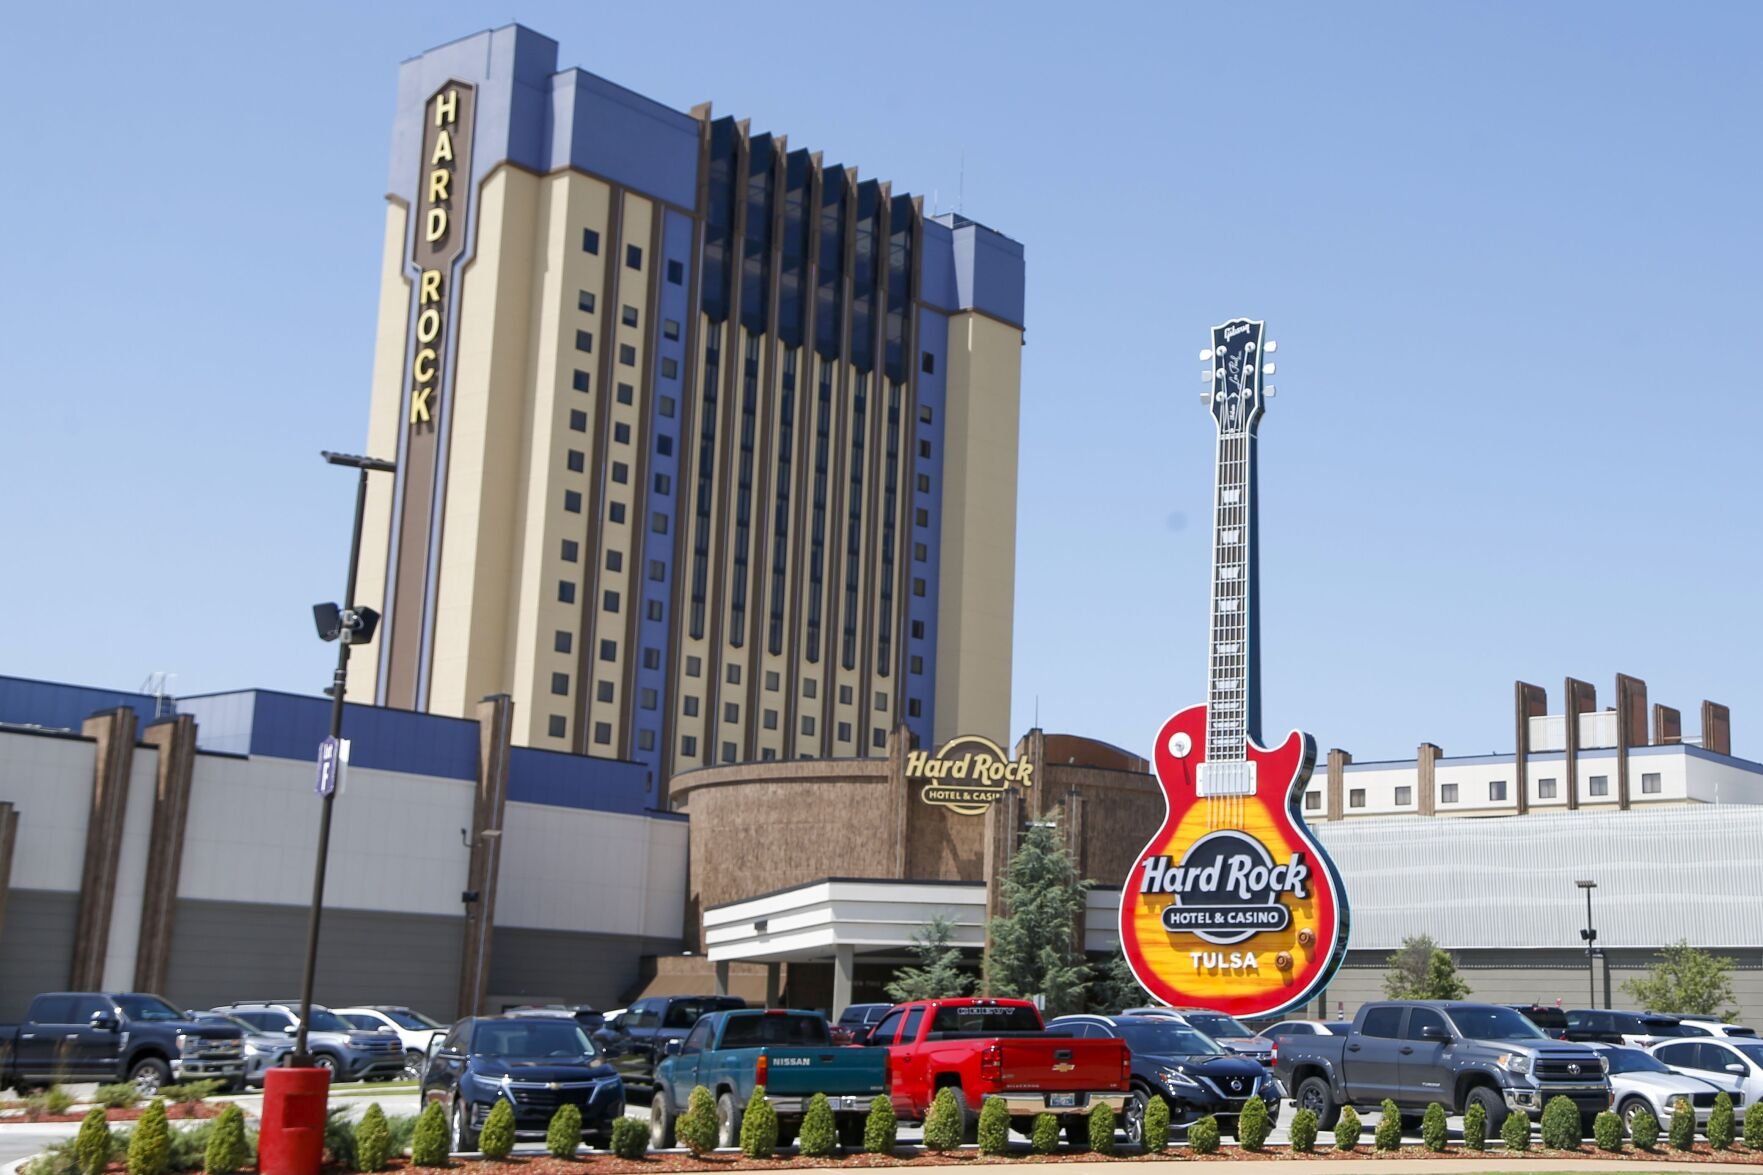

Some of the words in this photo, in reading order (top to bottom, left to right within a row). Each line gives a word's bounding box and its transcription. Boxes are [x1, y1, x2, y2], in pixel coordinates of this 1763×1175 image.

[426, 90, 457, 242] HARD
[410, 269, 442, 424] ROCK
[905, 751, 972, 778] Hard
[972, 754, 1034, 787] Rock
[929, 790, 961, 800] HOTEL
[962, 792, 971, 800] &
[1140, 854, 1224, 894] Hard
[1225, 852, 1309, 899] Rock
[1170, 912, 1212, 924] HOTEL
[1214, 912, 1225, 923] &
[1227, 911, 1279, 924] CASINO
[1190, 952, 1258, 969] TULSA
[957, 1007, 1016, 1015] CHEVY
[773, 1057, 811, 1066] NISSAN
